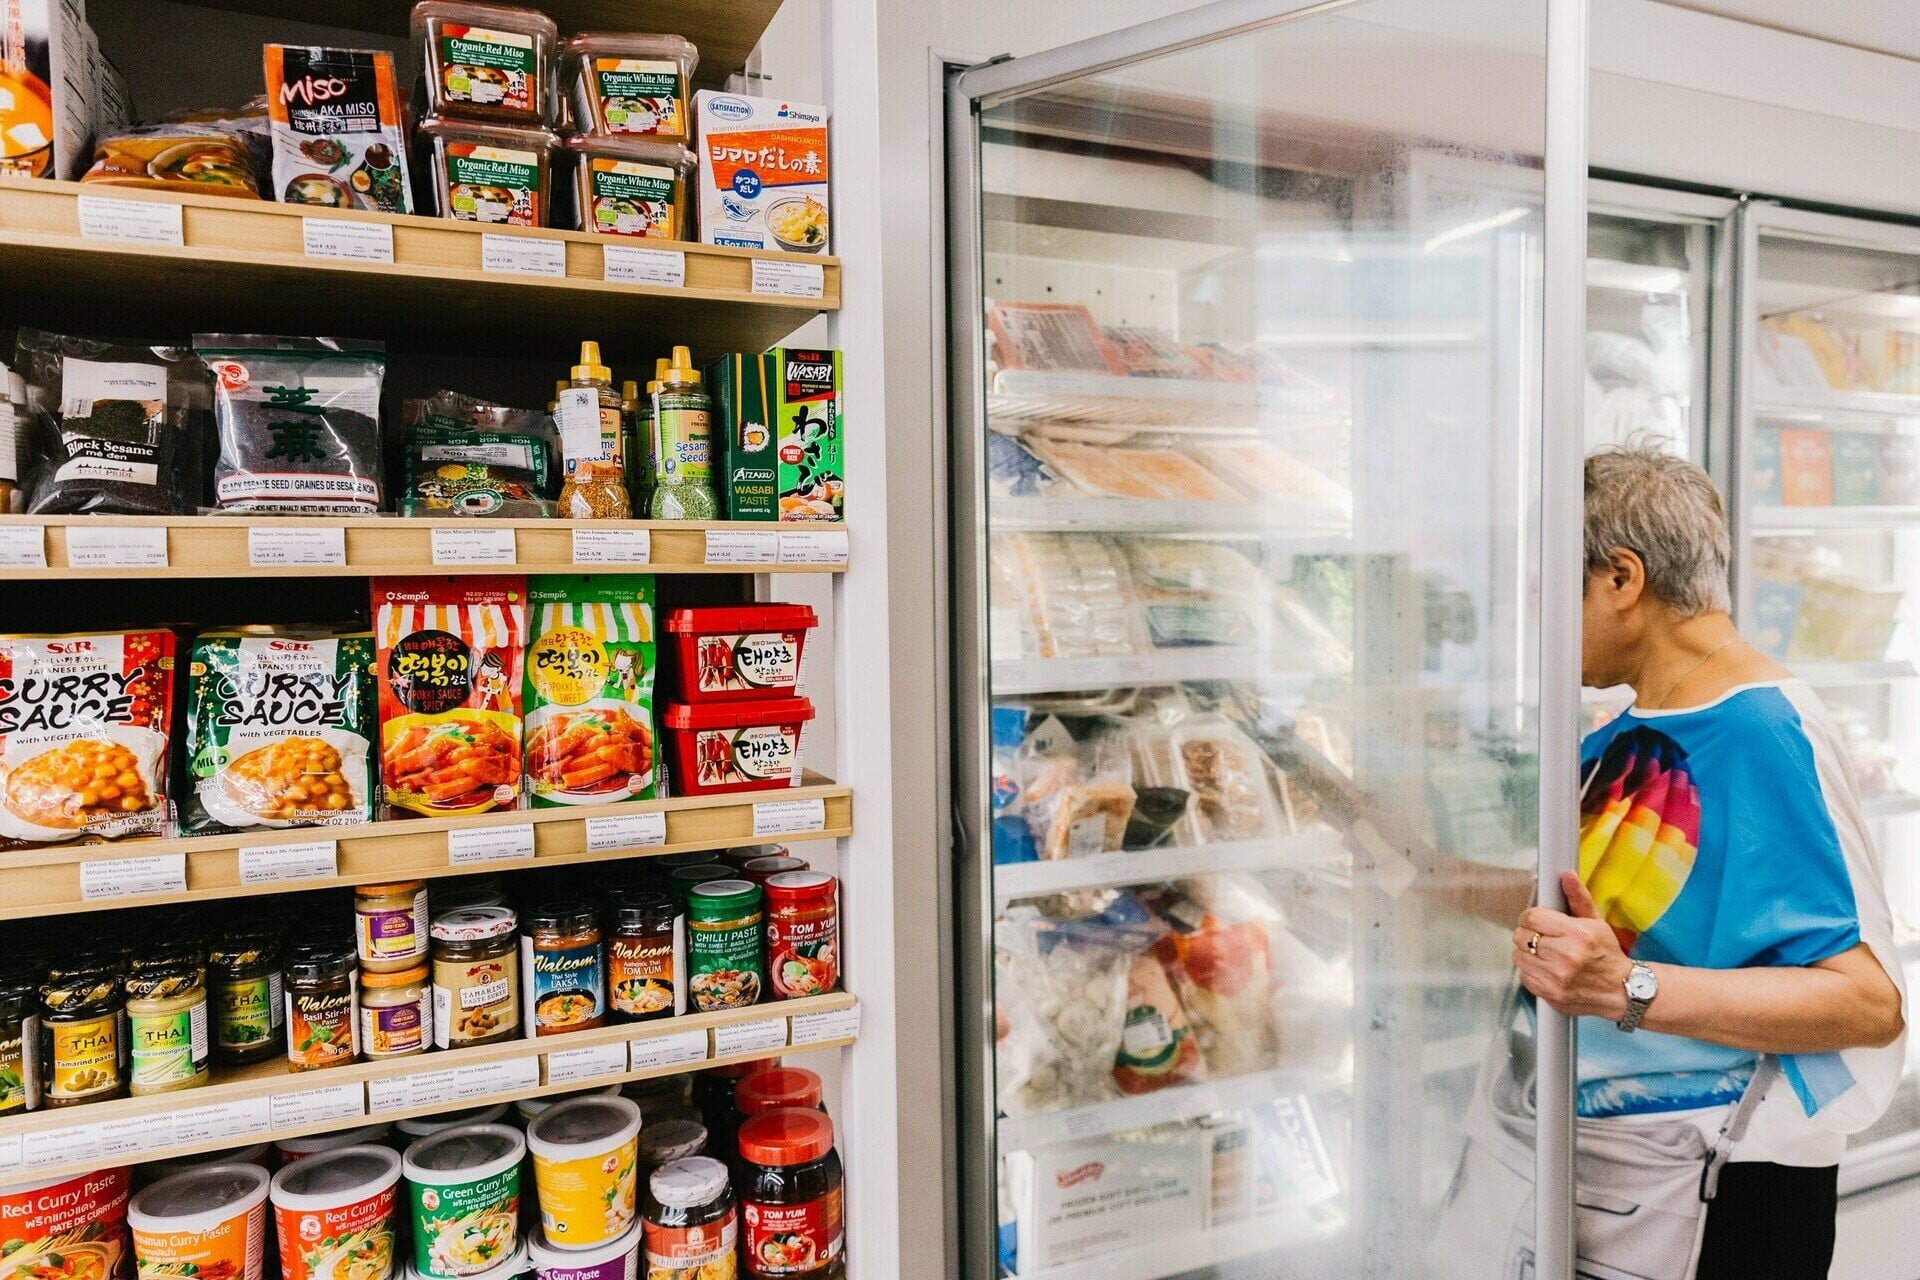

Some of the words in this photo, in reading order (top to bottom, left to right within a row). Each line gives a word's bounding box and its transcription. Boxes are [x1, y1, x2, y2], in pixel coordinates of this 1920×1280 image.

[450, 39, 485, 52] Organic
[486, 44, 503, 55] Red
[503, 46, 525, 59] Miso
[602, 72, 633, 85] Organic
[633, 73, 656, 84] White
[656, 75, 675, 85] Miso
[320, 104, 344, 116] AKA
[345, 102, 376, 115] MISO
[712, 102, 749, 114] SATISFACTION
[789, 111, 820, 123] Shimaya
[456, 158, 491, 172] Organic
[491, 163, 508, 174] Red
[508, 165, 530, 176] Miso
[712, 146, 822, 175] シマヤだしの素
[597, 172, 628, 185] Organic
[628, 177, 651, 188] White
[651, 179, 671, 190] Miso
[735, 175, 759, 186] かつお
[739, 184, 754, 194] だし
[786, 361, 833, 383] WASABI
[66, 439, 101, 458] Black
[103, 441, 154, 457] Sesame
[675, 442, 711, 452] Sesame
[791, 405, 832, 496] わさび
[679, 452, 708, 463] Seeds
[105, 469, 134, 479] PRIDE
[270, 480, 290, 490] SEED
[295, 480, 325, 490] GRAINES
[326, 480, 335, 490] DE
[336, 480, 362, 492] SESAE
[734, 486, 774, 495] WASABI
[739, 496, 769, 506] PASTE
[395, 590, 430, 601] Sempio
[537, 590, 567, 600] Sempio
[47, 641, 91, 654] S&B
[269, 640, 310, 651] S&B
[738, 645, 793, 666] 태양초
[28, 666, 77, 675] JANESE
[80, 664, 108, 672] STYLE
[297, 663, 322, 671] STYLE
[397, 652, 468, 687] 떡볶이
[450, 674, 467, 686] 소스
[536, 648, 600, 680] 떡볶이
[0, 667, 143, 705] CURRY
[217, 671, 352, 701] CURRY
[438, 689, 462, 699] SAUCE
[217, 699, 346, 726] SAUCE
[423, 701, 444, 711] SPICY
[239, 730, 261, 738] with
[263, 729, 322, 737] VEGETABLES
[16, 736, 40, 745] with
[735, 738, 791, 759] 태양초
[196, 752, 228, 770] MILD
[332, 818, 343, 826] OZ
[344, 818, 357, 826] 210
[789, 923, 814, 935] TOM
[820, 916, 835, 930] YUM
[696, 932, 728, 942] CHILLI
[731, 926, 758, 940] PASTE
[730, 940, 745, 948] BASIL
[613, 942, 673, 960] Valcom
[534, 954, 596, 973] Valcom
[563, 972, 578, 980] Style
[623, 967, 641, 975] TOM
[643, 966, 662, 975] YUM
[550, 979, 579, 988] LAKSA
[463, 982, 506, 999] TAMARIND
[232, 993, 266, 1006] THAI
[464, 996, 484, 1005] PASTE
[249, 1010, 269, 1020] paste
[303, 1013, 323, 1022] Basil
[145, 1027, 186, 1041] THAI
[71, 1033, 113, 1050] THAI
[56, 1058, 94, 1068] Tamarind
[94, 1053, 115, 1063] paste
[442, 1188, 474, 1200] Green
[475, 1179, 501, 1194] Curry
[502, 1167, 519, 1184] Paste
[2, 1200, 33, 1219] Red
[37, 1190, 81, 1210] Curry
[84, 1174, 116, 1197] Paste
[50, 1222, 73, 1234] PATE
[74, 1215, 86, 1226] DE
[87, 1203, 111, 1221] CURRY
[325, 1210, 348, 1225] Red
[350, 1199, 379, 1218] Curry
[763, 1210, 784, 1219] TOM
[785, 1208, 807, 1219] YUM
[169, 1234, 200, 1247] Curry
[202, 1224, 232, 1241] Paste
[552, 1270, 575, 1280] Curry
[576, 1269, 600, 1280] Paste
